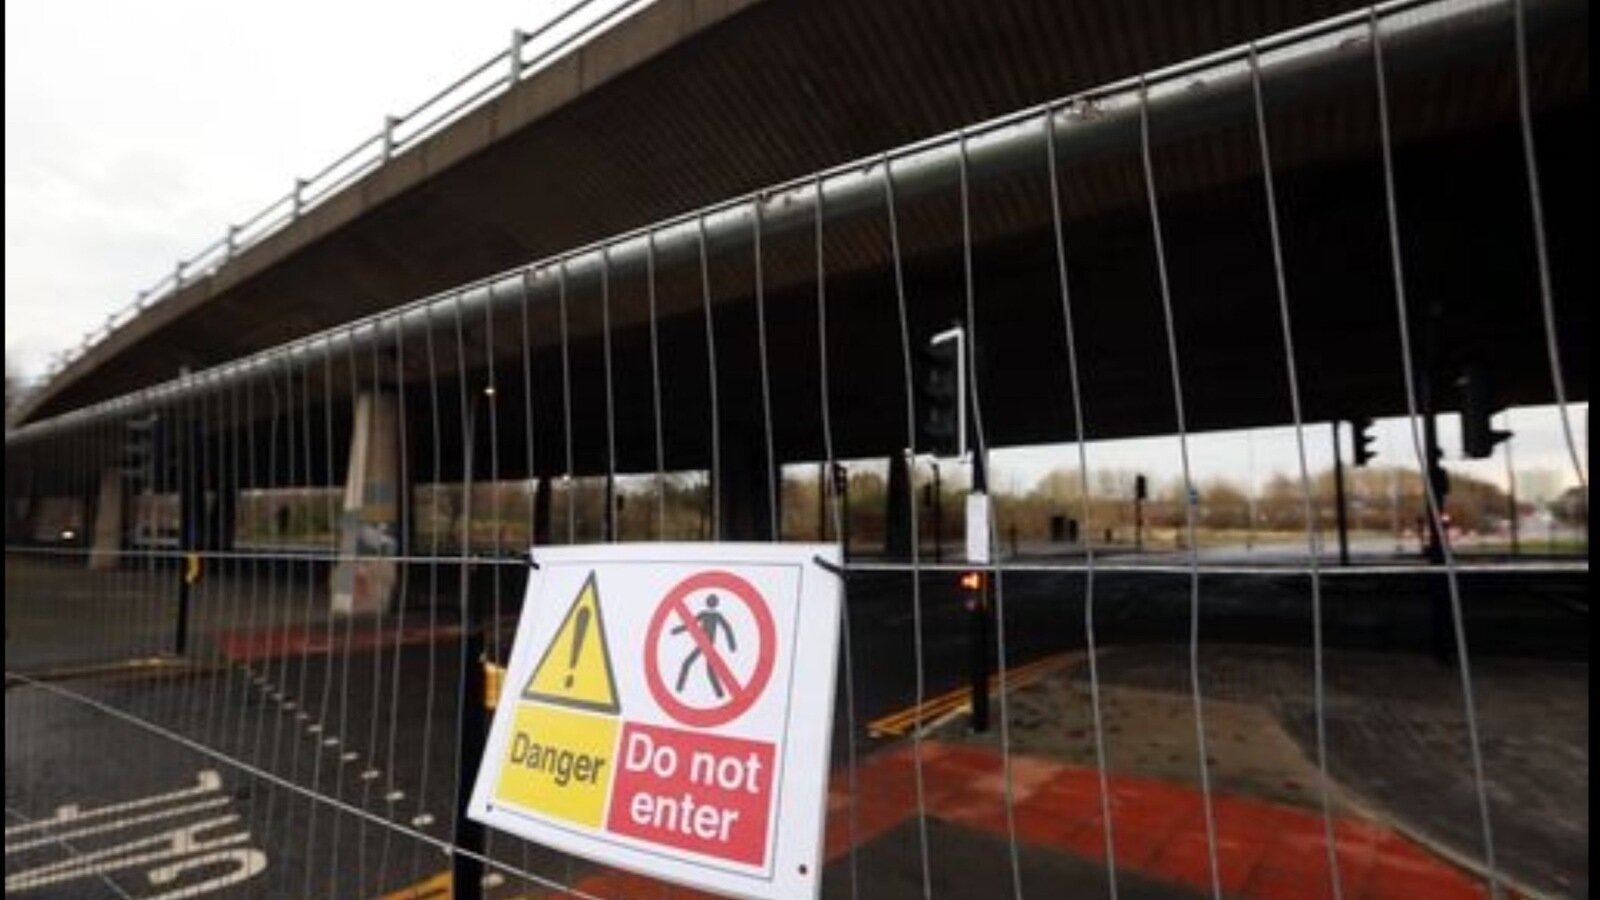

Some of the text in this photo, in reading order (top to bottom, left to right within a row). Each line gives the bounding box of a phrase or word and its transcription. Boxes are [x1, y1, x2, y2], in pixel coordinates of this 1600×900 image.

[510, 732, 606, 787] Danger
[625, 732, 762, 794] Do not
[630, 791, 739, 843] enter
